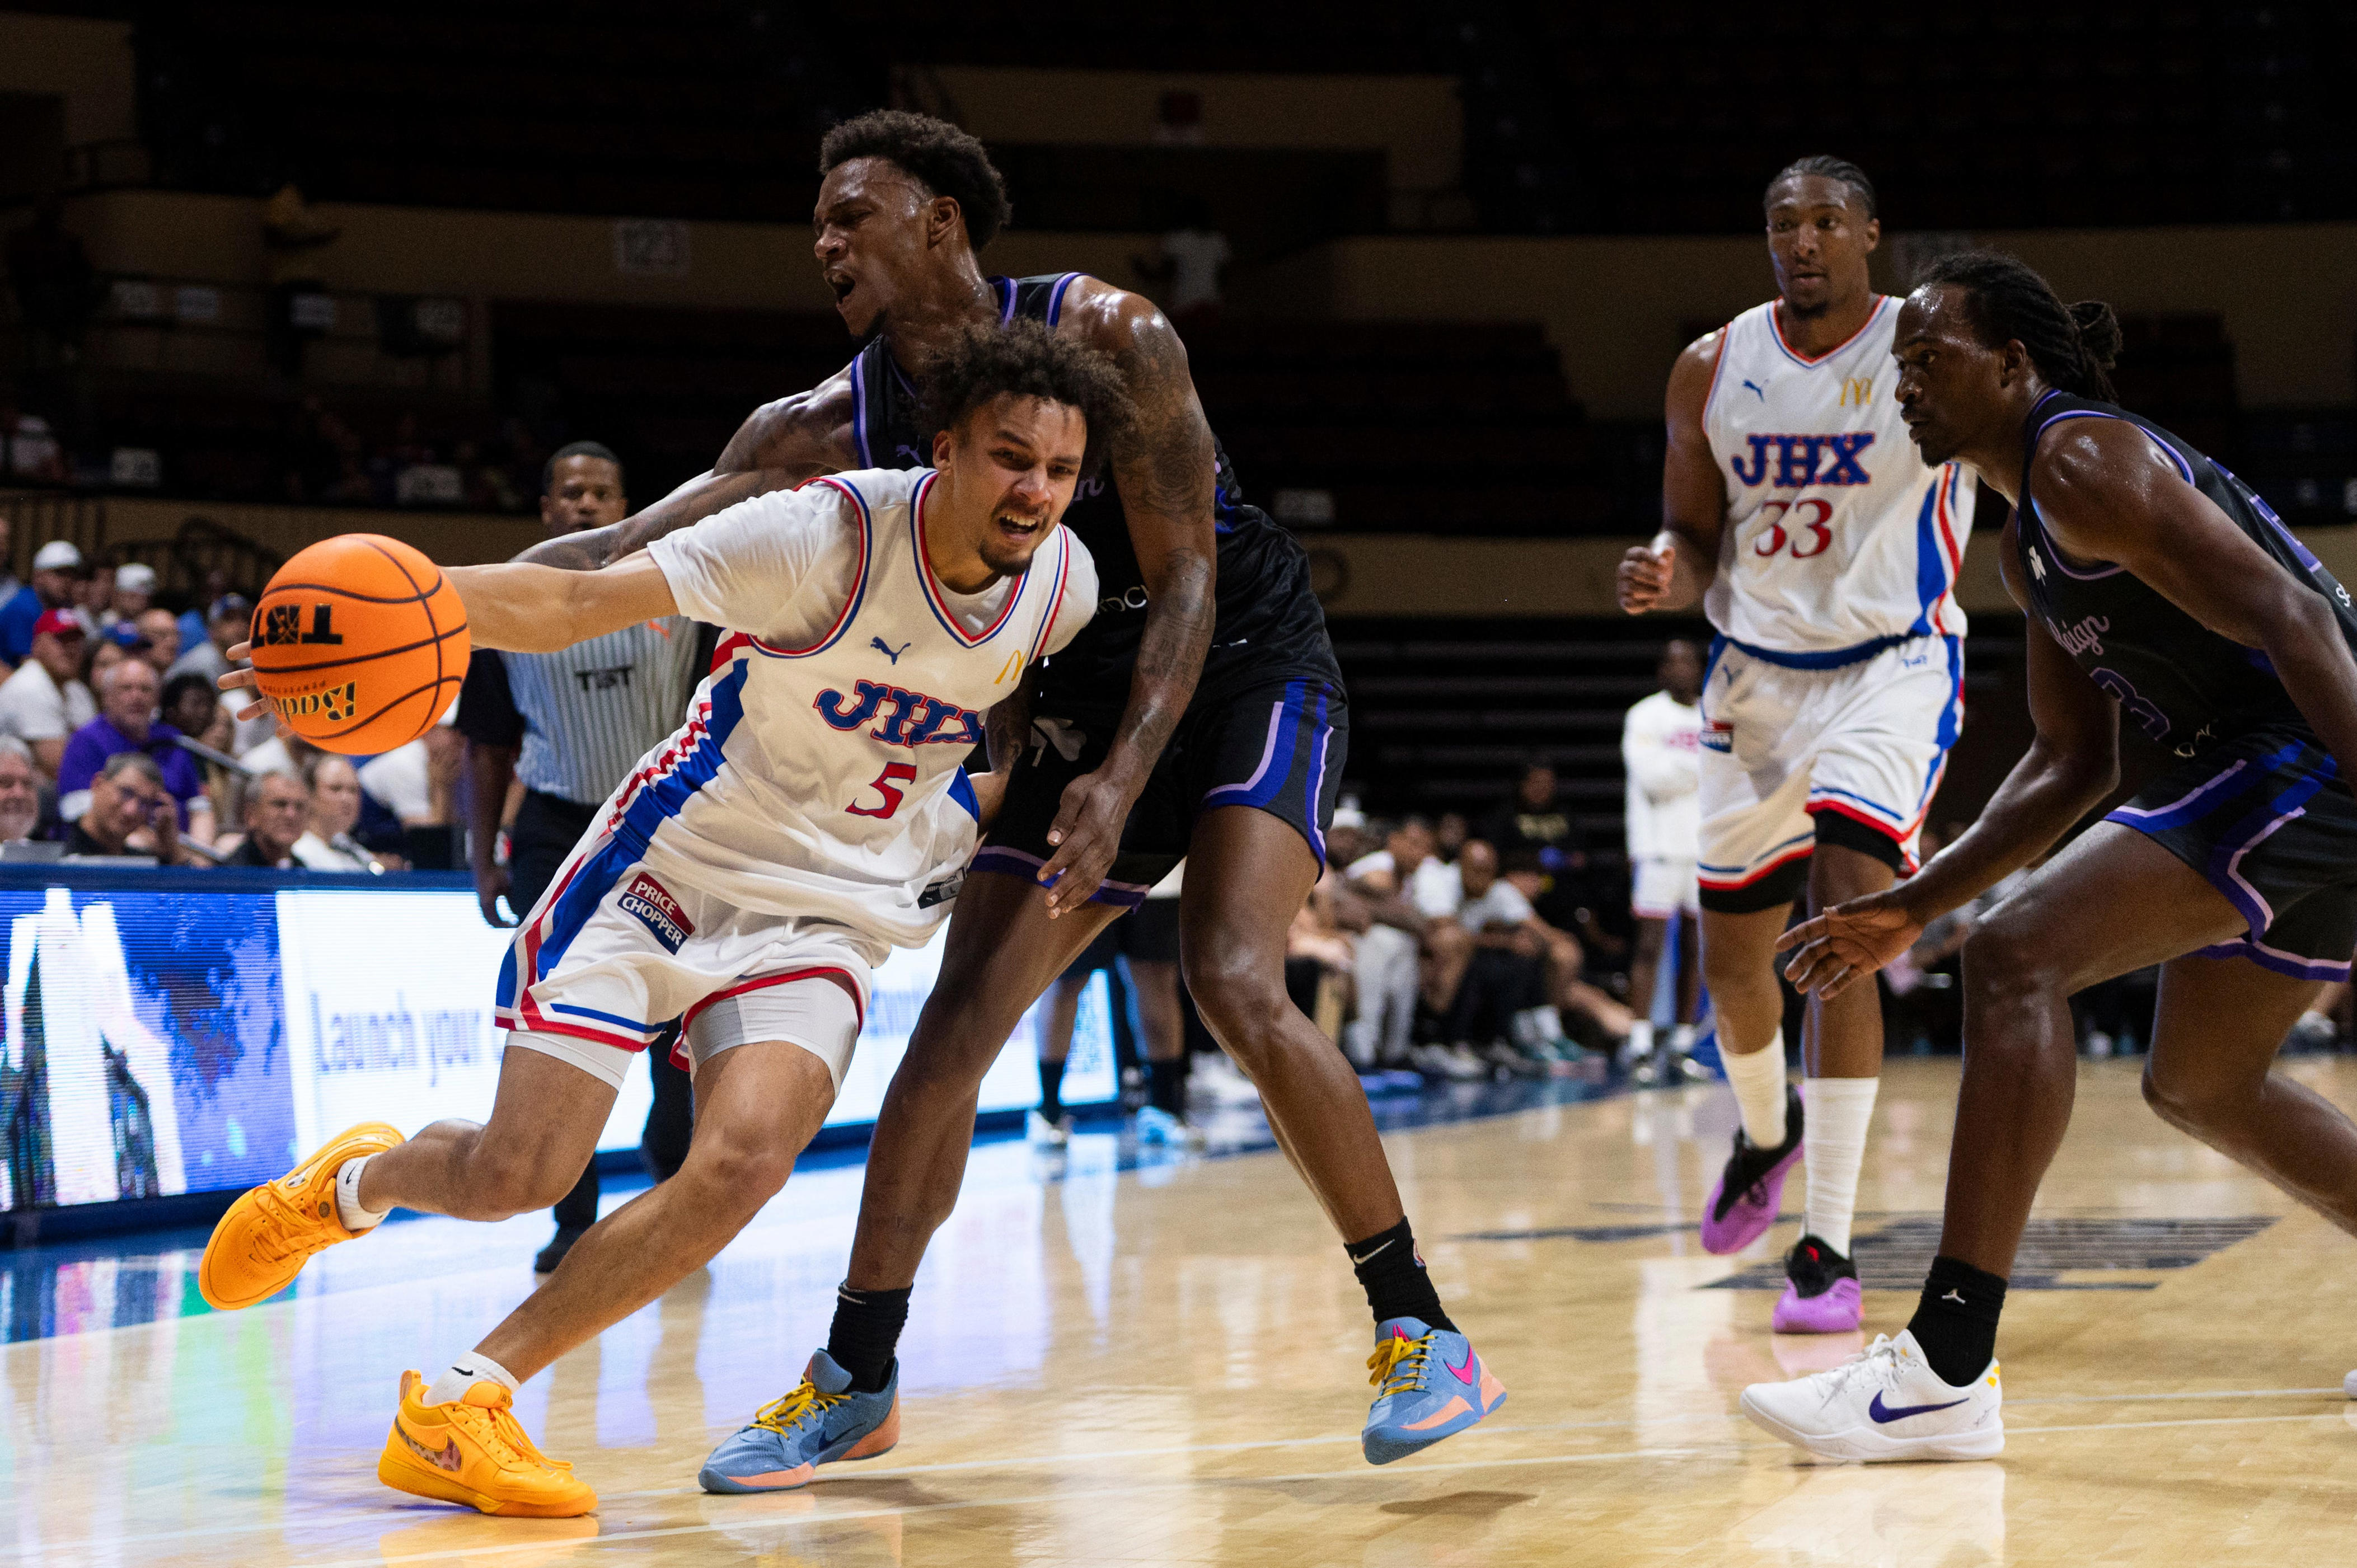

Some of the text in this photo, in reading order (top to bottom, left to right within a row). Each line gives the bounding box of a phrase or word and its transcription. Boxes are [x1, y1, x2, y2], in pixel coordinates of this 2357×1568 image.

[1731, 430, 1876, 487] JHX
[1755, 497, 1833, 558] 33
[251, 603, 343, 649] TBT
[271, 680, 357, 724] Bad
[813, 679, 984, 749] JHX
[844, 761, 917, 820] 5
[622, 896, 682, 946] CHOPPER
[634, 880, 677, 916] PRICE
